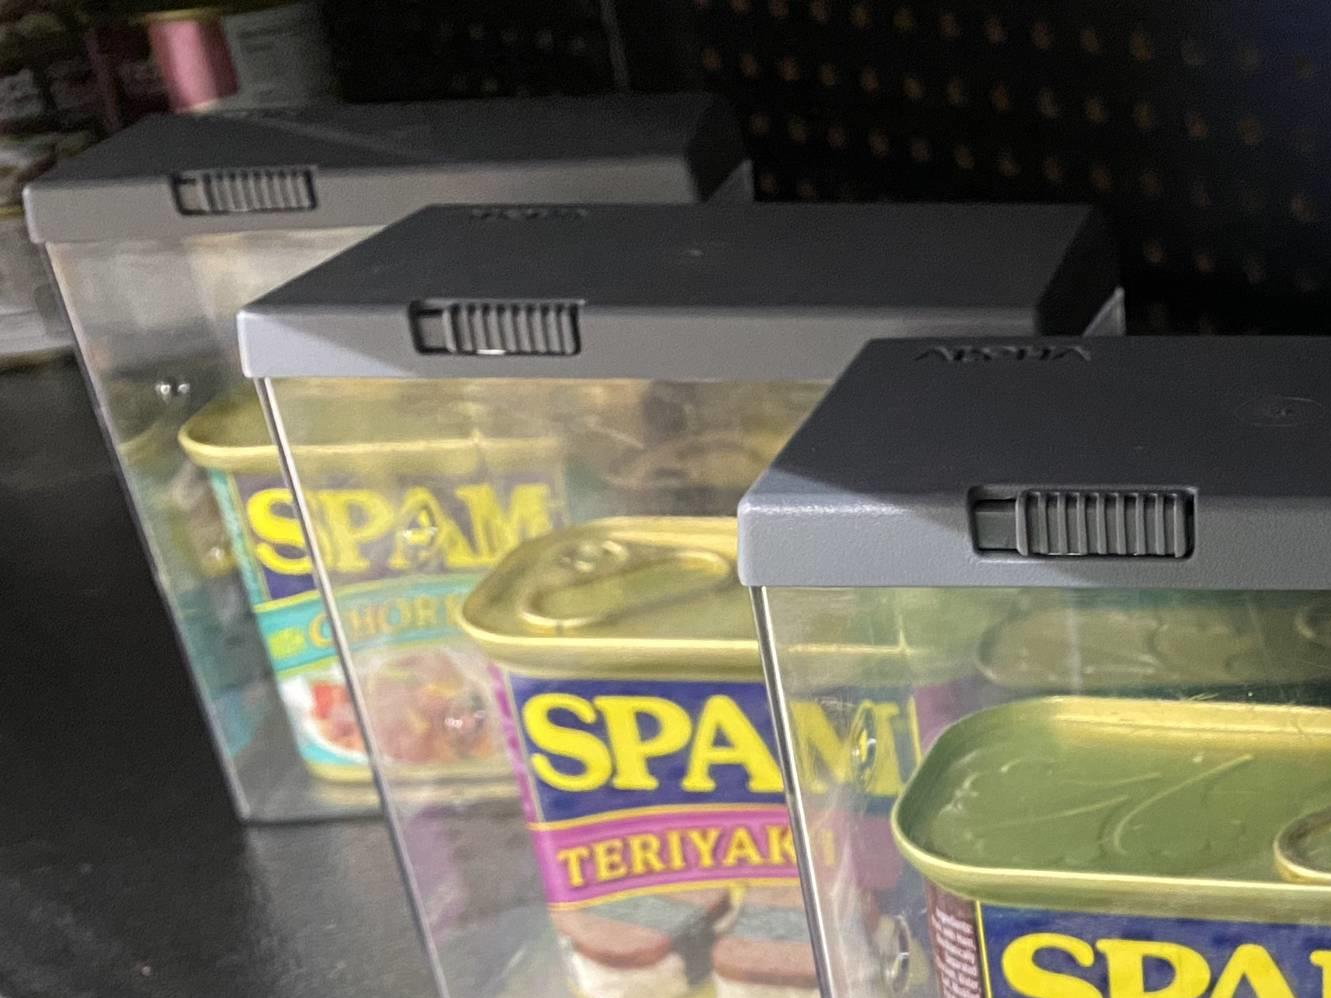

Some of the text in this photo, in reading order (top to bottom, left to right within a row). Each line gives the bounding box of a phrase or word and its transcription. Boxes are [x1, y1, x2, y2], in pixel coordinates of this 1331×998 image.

[247, 483, 551, 575] SPAM
[522, 693, 901, 797] SPAM
[556, 825, 836, 889] TERIYAKI
